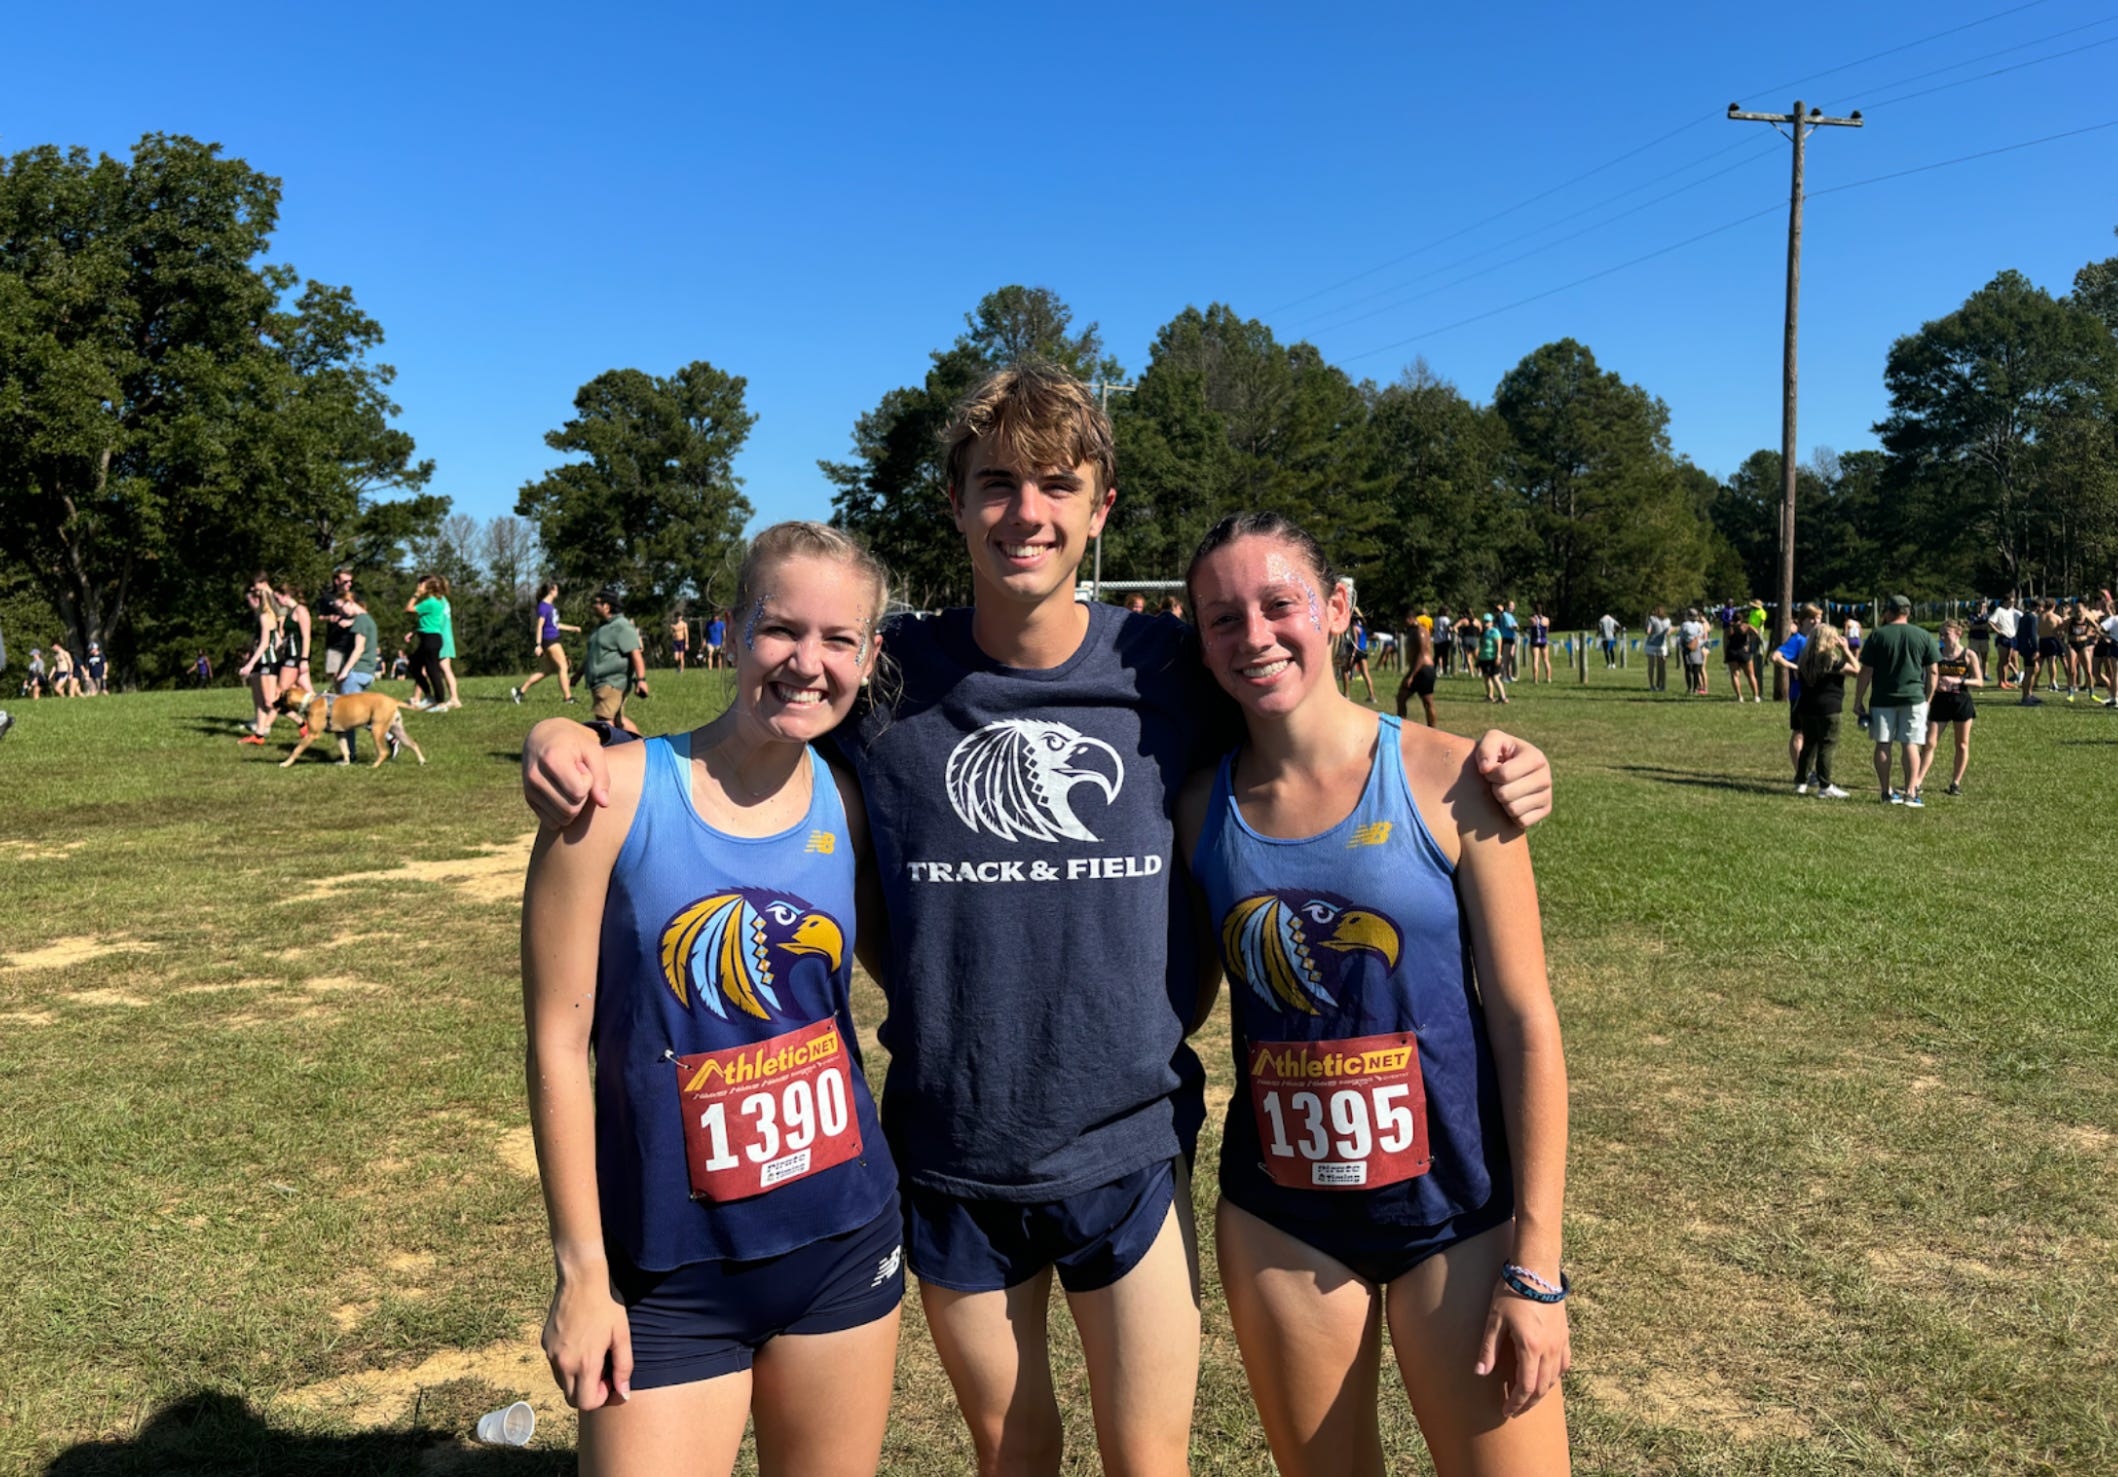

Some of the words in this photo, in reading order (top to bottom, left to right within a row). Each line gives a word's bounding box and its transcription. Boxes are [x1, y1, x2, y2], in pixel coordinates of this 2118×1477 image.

[907, 861, 1026, 882] TRACK
[1029, 860, 1060, 881] &
[1067, 855, 1163, 880] FIELD
[701, 1068, 848, 1172] 1390
[1263, 1084, 1413, 1160] 1395
